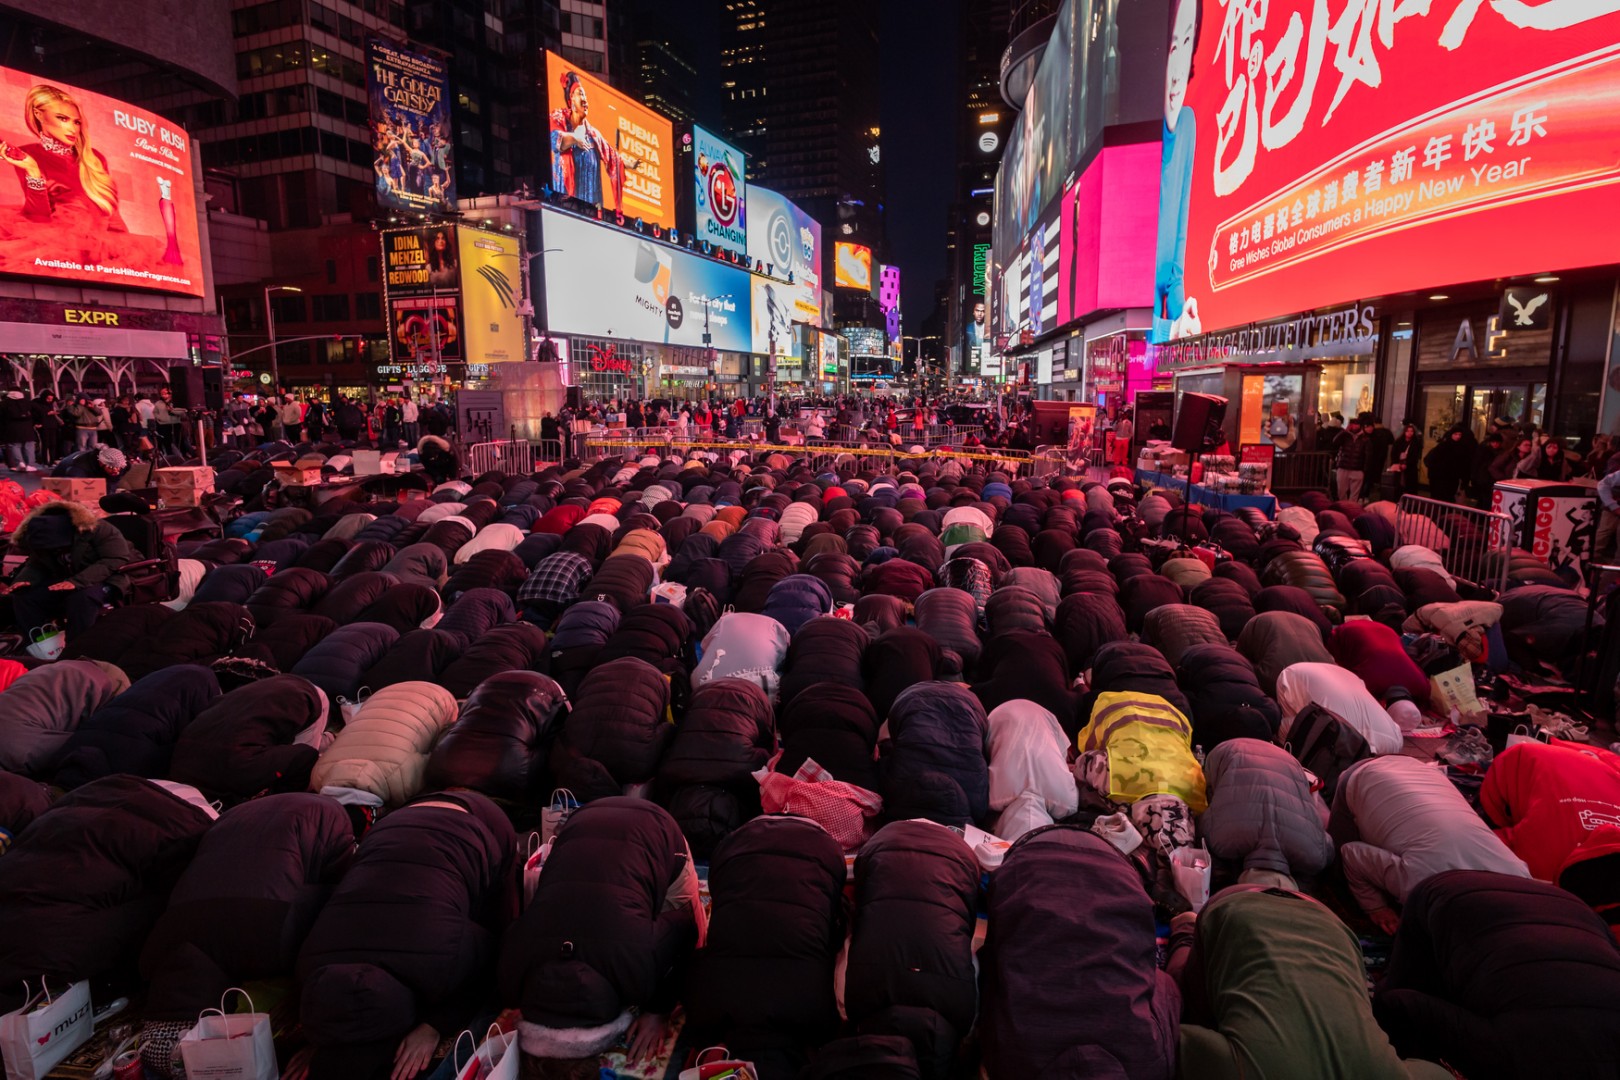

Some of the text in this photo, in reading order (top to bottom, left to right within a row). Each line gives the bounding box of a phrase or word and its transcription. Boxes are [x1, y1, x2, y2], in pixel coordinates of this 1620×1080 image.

[373, 64, 442, 102] THE GREAT
[383, 86, 436, 113] GATSBY
[114, 110, 186, 153] RUBY RUSH
[619, 116, 660, 149] BUENA
[620, 133, 660, 166] VISTA
[700, 140, 725, 161] ALWAY
[624, 171, 662, 200] CLUB
[1229, 102, 1548, 256] 格力电器祝全球消费者新年快乐
[1229, 157, 1532, 272] Gree Wishes Global Consumers a Happy New Year
[390, 250, 426, 266] MENZEL
[394, 235, 420, 251] IDINA
[35, 257, 191, 286] Available at ParisHiltonFragrances.com
[388, 269, 429, 285] REDWOOD
[635, 295, 663, 317] MIGHTY
[1206, 329, 1248, 361] EAGLE
[1248, 305, 1375, 354] OUTFITTERS
[1450, 314, 1507, 360] AE
[377, 364, 447, 374] GIFTS LUGGGE
[468, 364, 489, 373] GIFTS
[1488, 489, 1503, 547] CAGO
[1532, 496, 1556, 564] ICAGO
